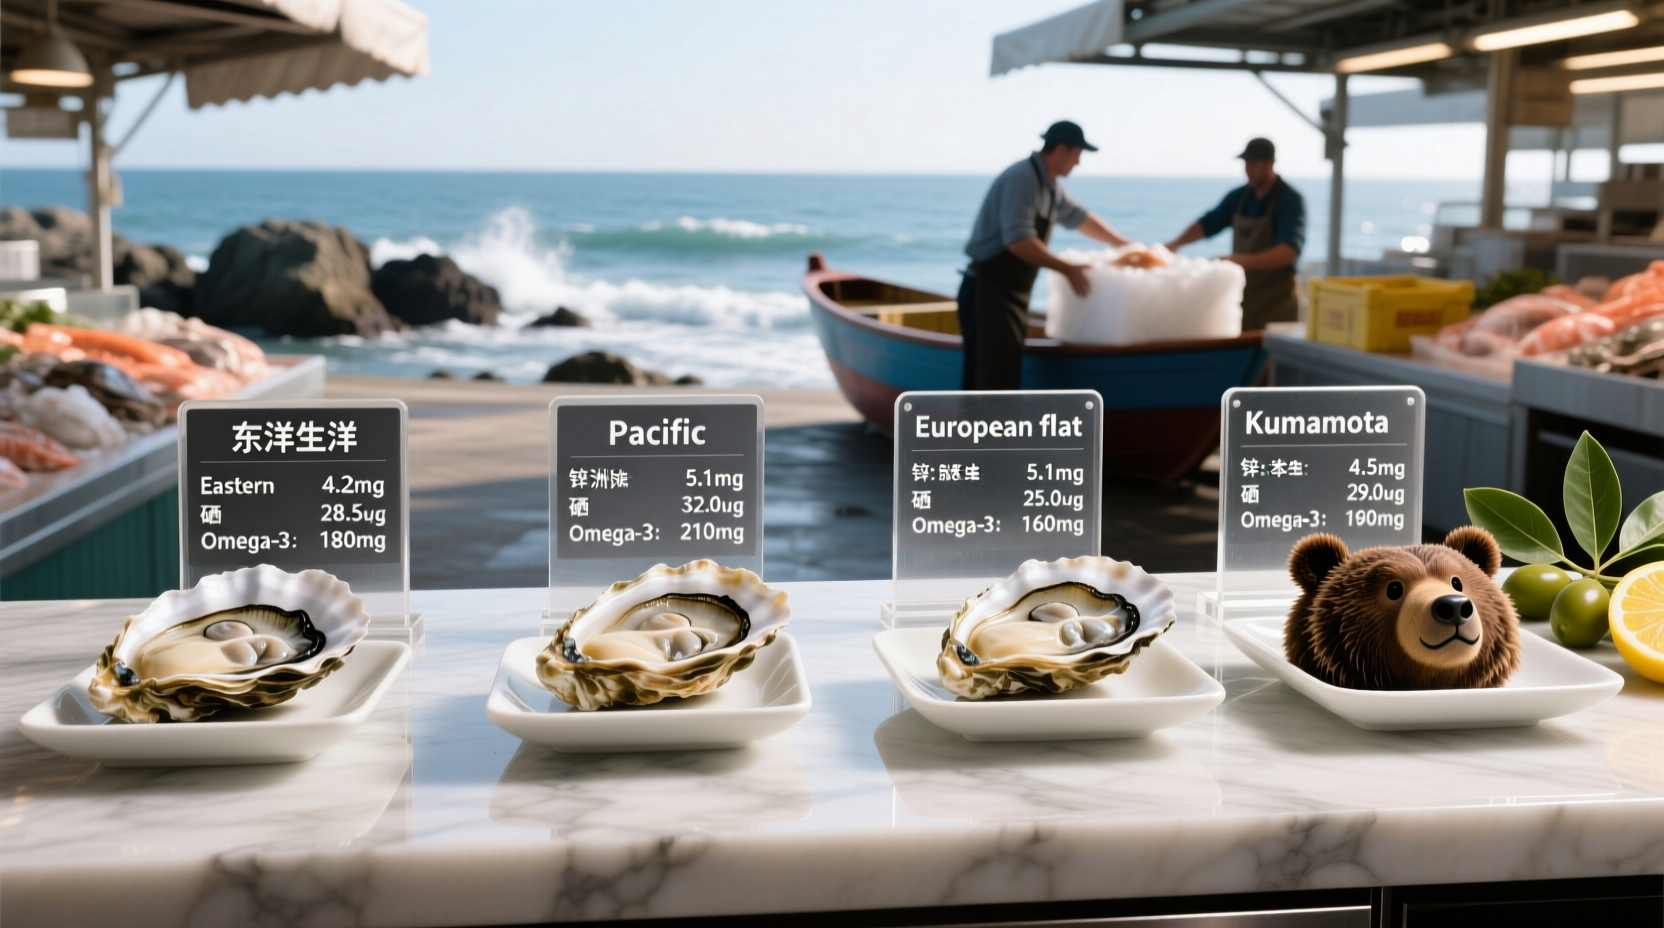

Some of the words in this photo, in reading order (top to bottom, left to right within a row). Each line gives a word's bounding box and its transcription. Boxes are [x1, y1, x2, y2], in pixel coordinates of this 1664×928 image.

[609, 418, 706, 445] Pacific
[916, 415, 1032, 443] European
[1039, 414, 1082, 437] flat
[1246, 410, 1388, 434] Kumamota
[232, 420, 358, 454] 东洋生洋
[686, 469, 744, 491] 5.1mg
[1027, 463, 1084, 485] 5.1mg
[1349, 458, 1405, 480] 4.5mg
[201, 476, 274, 495] Eastern
[322, 475, 384, 498] 4.2mg
[1347, 483, 1405, 505] 29.0ug
[682, 496, 744, 518] 32.0ug
[1023, 490, 1083, 511] 25.0ug
[321, 504, 386, 526] 28.5ug
[1241, 511, 1326, 532] Omega-3:
[569, 523, 660, 546] Omega-3:
[681, 522, 744, 544] 210mg
[912, 516, 1000, 538] Omega-3:
[1023, 515, 1084, 536] 160mg
[201, 531, 297, 554] Omega-3:
[320, 530, 386, 552] 180mg
